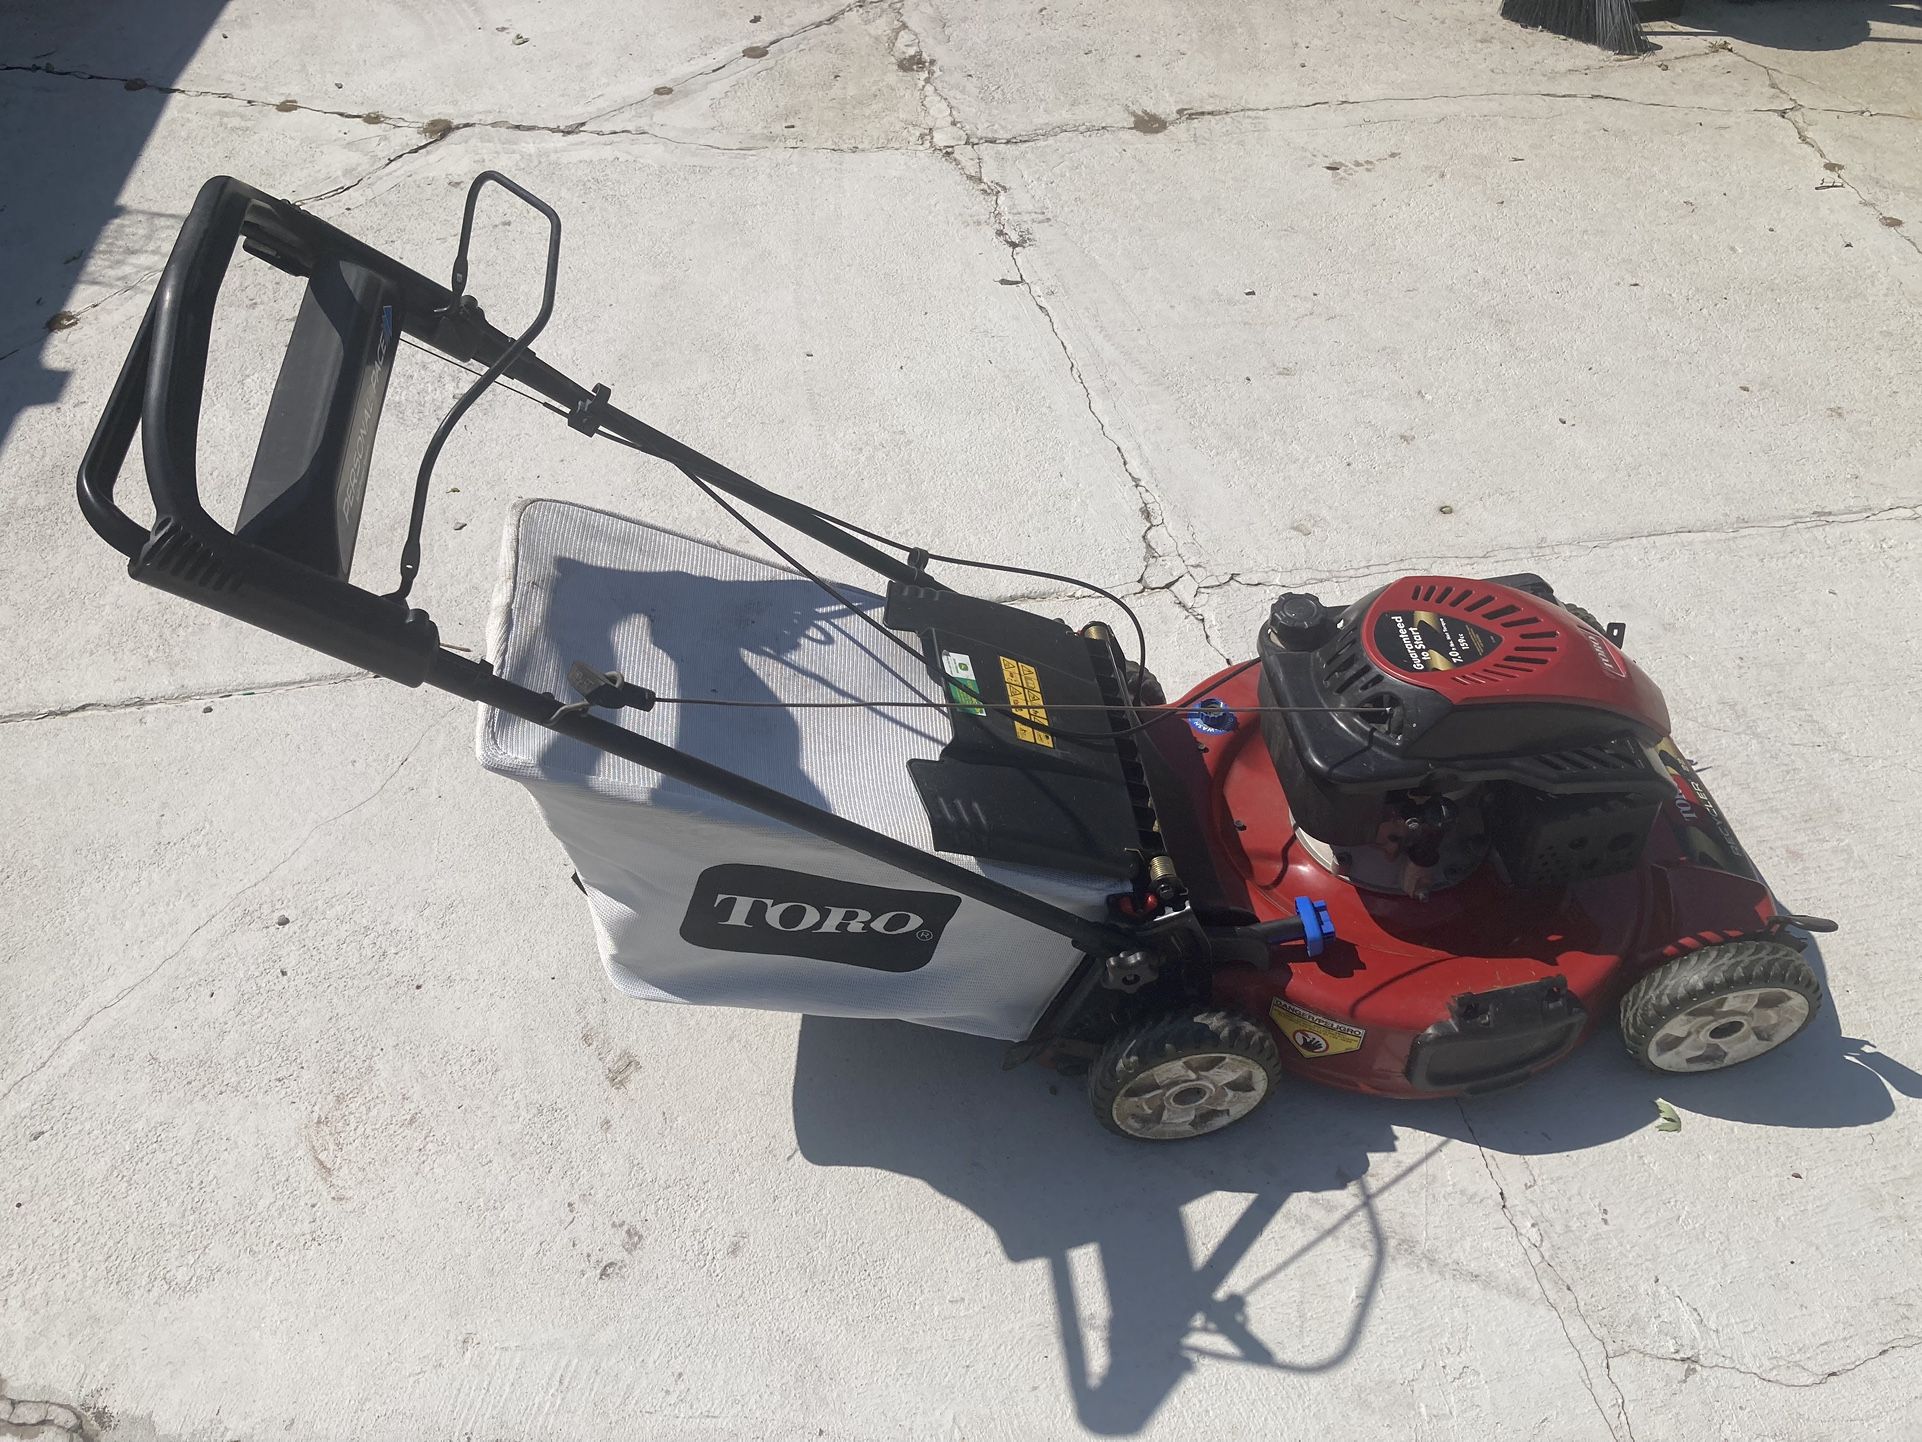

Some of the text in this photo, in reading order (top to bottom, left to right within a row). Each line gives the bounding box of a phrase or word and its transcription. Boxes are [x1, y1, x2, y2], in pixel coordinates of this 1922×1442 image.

[343, 401, 374, 524] PERSONAL
[371, 333, 387, 393] PACE
[1391, 616, 1424, 670] Guaranteed
[1409, 627, 1431, 660] to Start
[1449, 651, 1463, 663] 7.0
[1690, 781, 1741, 856] RECYCLER
[714, 894, 924, 935] TORO
